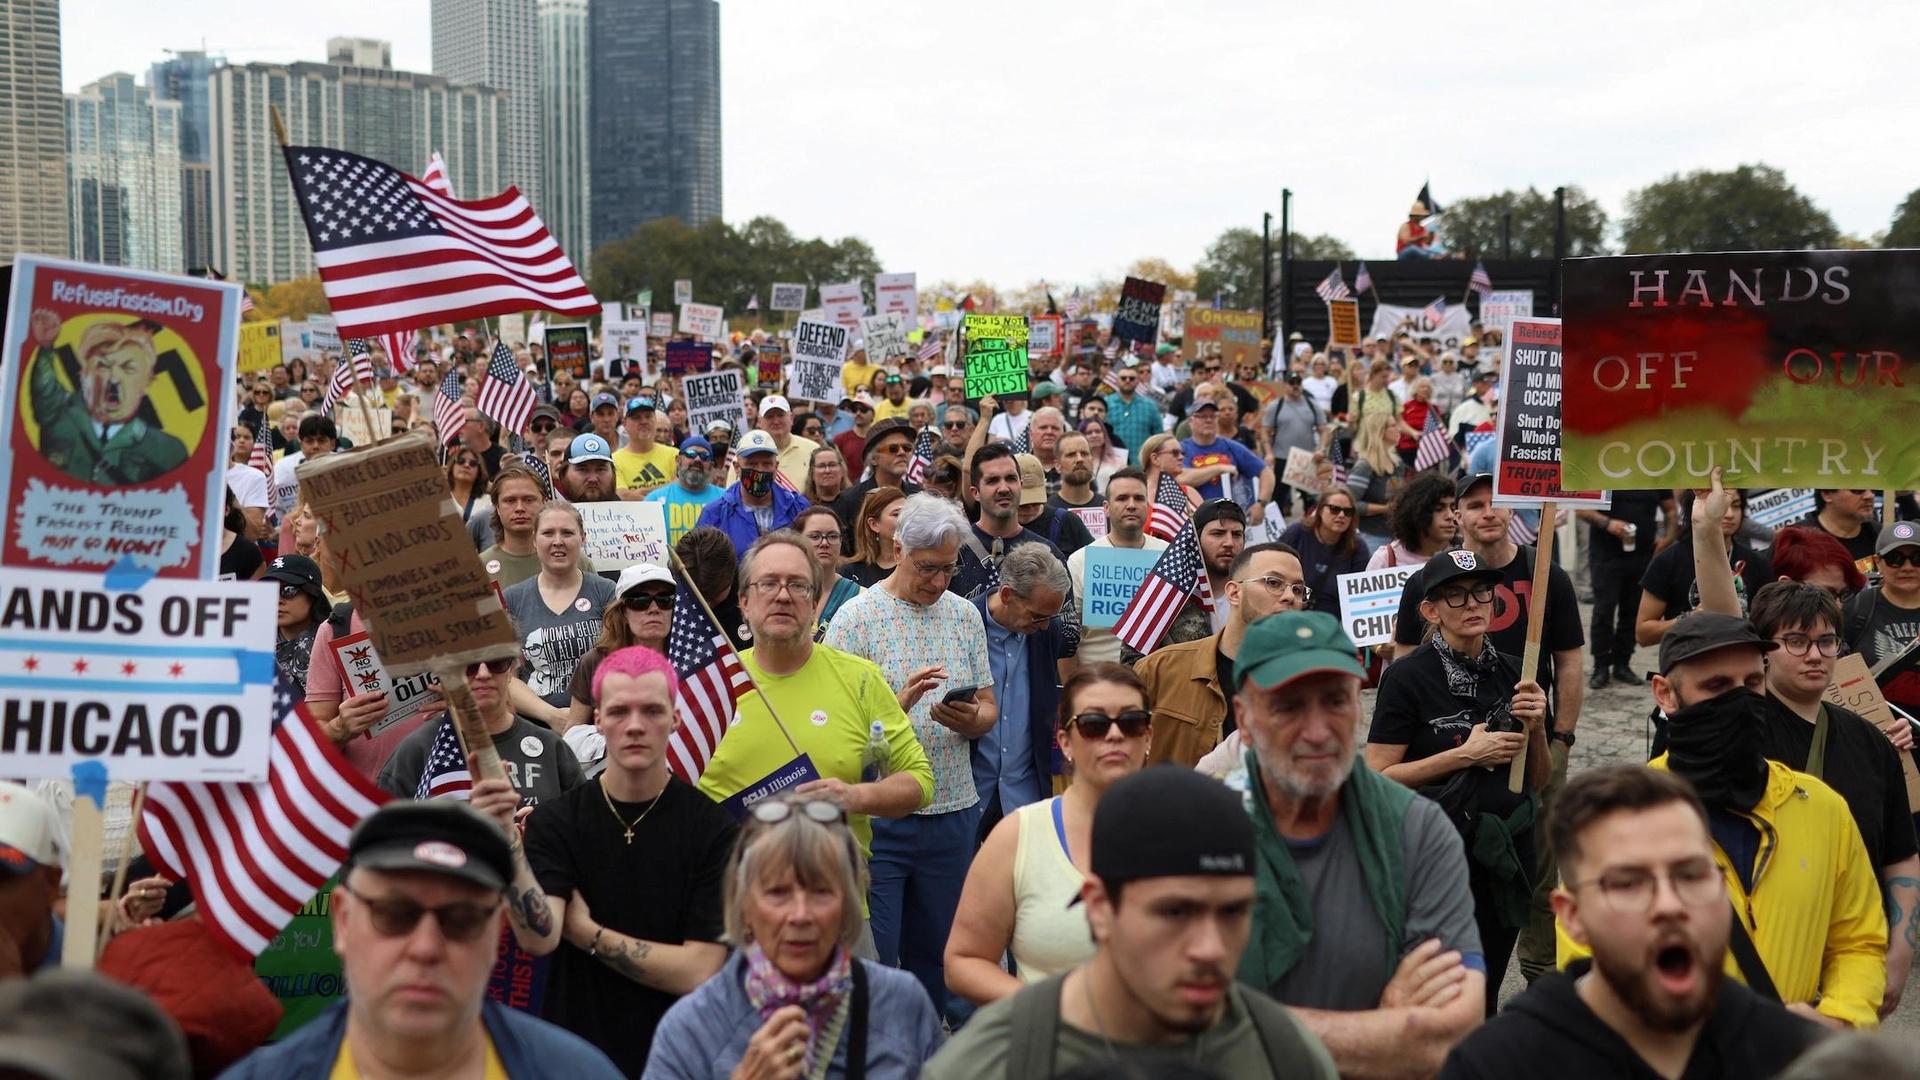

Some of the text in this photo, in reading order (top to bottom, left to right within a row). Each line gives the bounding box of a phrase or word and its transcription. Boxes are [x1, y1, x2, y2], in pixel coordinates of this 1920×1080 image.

[1629, 265, 1851, 308] HANDS
[52, 280, 204, 322] RefuseFascism.Org
[967, 316, 1023, 325] THIS IS NOT
[799, 321, 846, 348] DEFEND
[977, 327, 1029, 338] INSURRECTION
[796, 342, 843, 361] DEMOCRACY:
[1195, 341, 1221, 359] ICE
[1515, 348, 1547, 367] SHUT
[810, 362, 827, 376] TIME
[827, 364, 841, 378] FOR
[966, 350, 1028, 376] PEACEFUL
[1592, 350, 1698, 392] OFF
[1783, 348, 1905, 388] OUR
[686, 373, 738, 398] DEFEND
[804, 373, 834, 390] GENERAL
[966, 372, 1025, 398] PROTEST
[1526, 371, 1543, 388] NO
[688, 392, 741, 410] DEMOCRACY:
[1523, 390, 1562, 407] OCCUP
[727, 407, 743, 420] FOR
[1517, 413, 1562, 430] Shut Do
[1521, 429, 1557, 445] Whole
[1510, 445, 1554, 462] Fascist
[1598, 437, 1888, 479] COUNTRY
[307, 473, 332, 499] NO
[332, 466, 367, 491] MORE
[1506, 465, 1558, 479] TRUMP
[1520, 481, 1542, 494] GO
[52, 501, 164, 518] THE TRUMP
[340, 476, 445, 526] BILLIONAIRES
[1748, 492, 1790, 515] HANDS
[36, 514, 180, 539] FASCIST REGIME
[1083, 512, 1104, 524] KING
[40, 534, 166, 556] MUST GO NOW!
[358, 520, 453, 567] LANDLORDS
[368, 556, 461, 593] COMPANIES WITH
[1346, 570, 1409, 596] HANDS
[0, 586, 250, 638] ANDS OFF
[1092, 600, 1131, 616] RIG
[388, 614, 497, 655] GENERAL STRIKE
[541, 618, 602, 643] WOMEN BELON
[544, 642, 556, 662] IN
[558, 638, 576, 660] ALL
[355, 658, 371, 668] NO
[550, 658, 575, 677] WHERE
[364, 681, 380, 691] NO
[394, 671, 441, 702] OLIG
[550, 677, 566, 695] ARE
[0, 698, 242, 758] HICAGO
[742, 765, 808, 807] ACLU Illinois
[509, 965, 533, 1009] THIS
